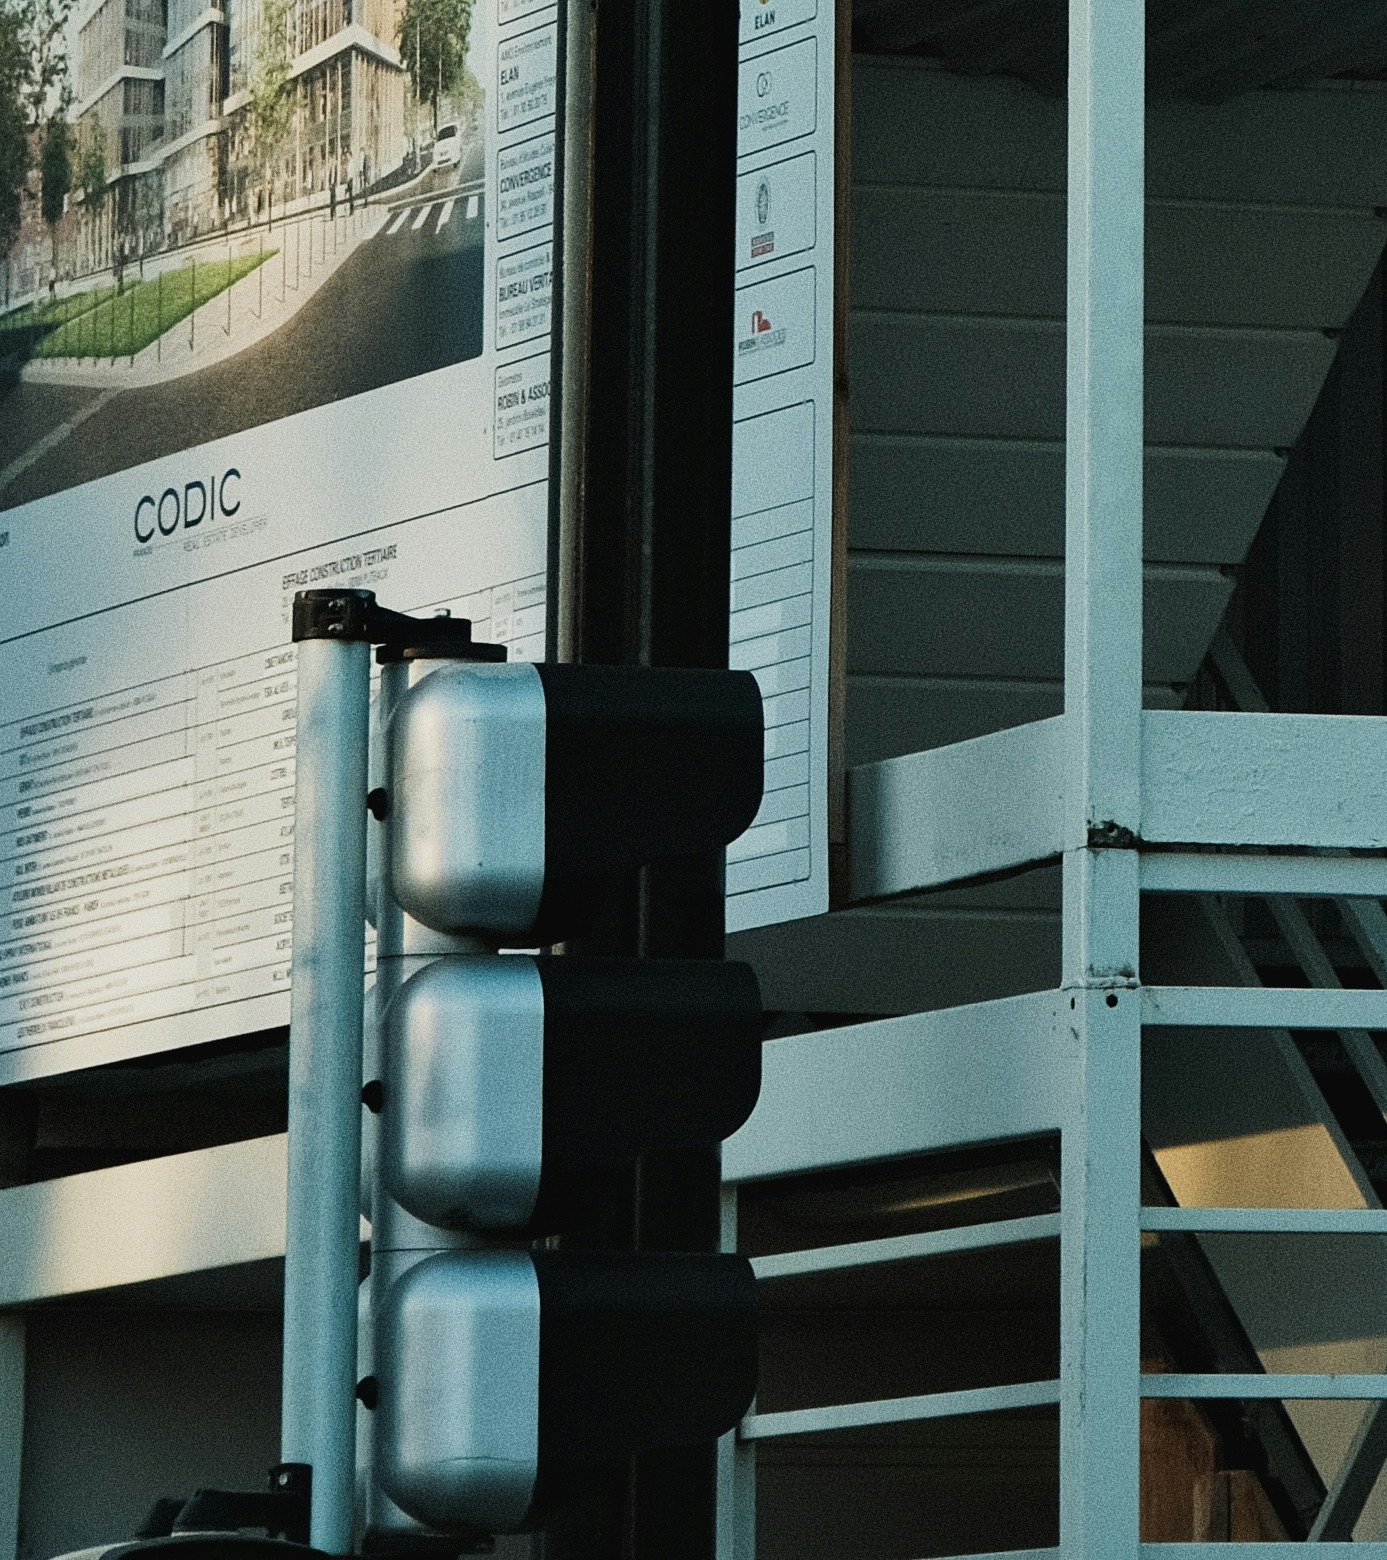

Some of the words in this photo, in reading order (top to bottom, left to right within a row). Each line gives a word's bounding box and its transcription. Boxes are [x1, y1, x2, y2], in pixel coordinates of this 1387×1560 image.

[754, 8, 776, 30] ELAN
[501, 65, 519, 86] ELAN
[500, 161, 552, 194] CONVERGENCE
[499, 282, 527, 303] BUREAU
[133, 468, 242, 544] CODIC
[309, 553, 362, 583] CONSTRUCTION
[362, 543, 397, 566] TERTIAIRE
